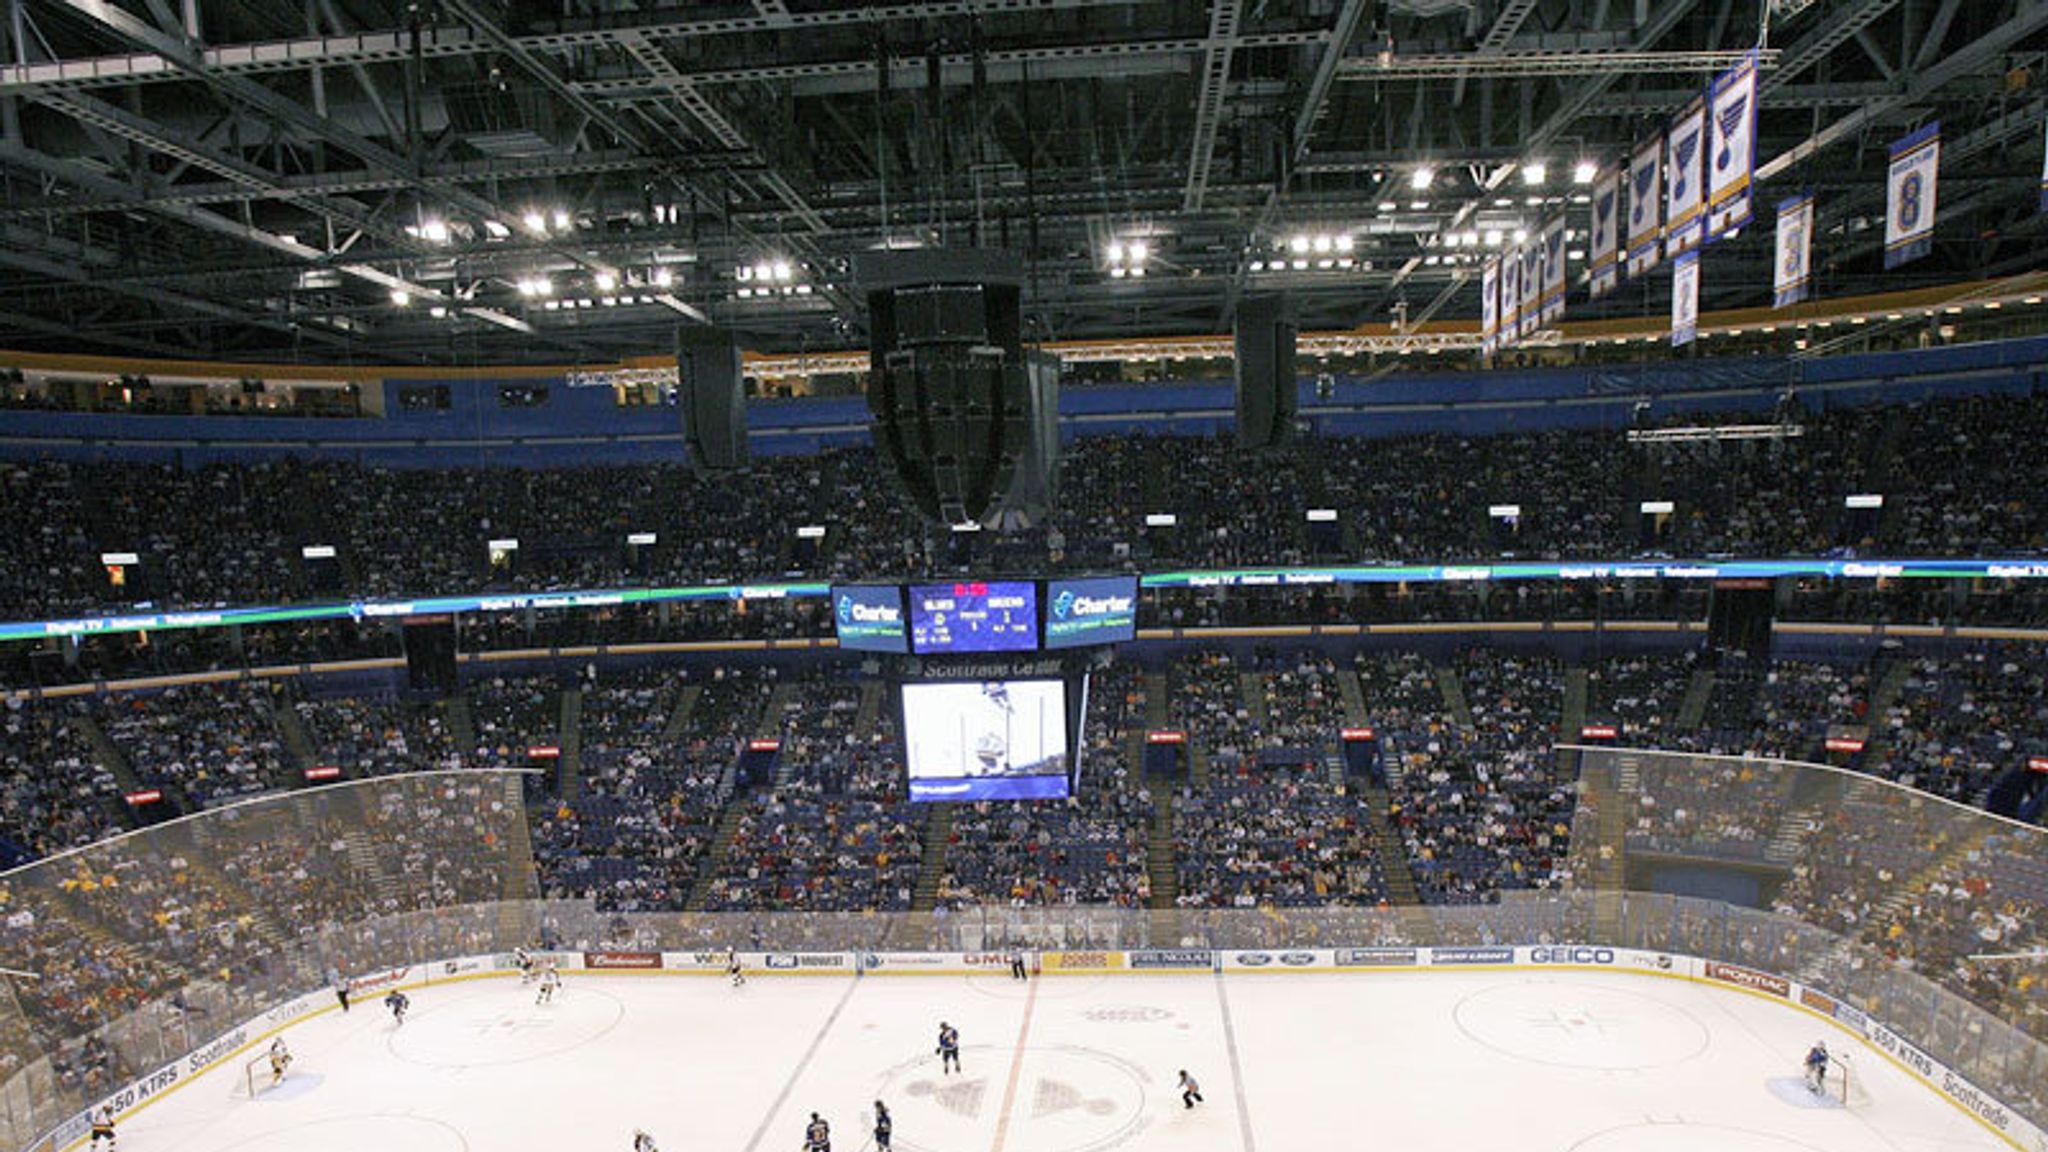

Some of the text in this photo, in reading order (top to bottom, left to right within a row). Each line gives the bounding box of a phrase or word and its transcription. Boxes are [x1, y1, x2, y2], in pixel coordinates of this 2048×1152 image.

[1898, 170, 1922, 233] 8
[852, 603, 899, 621] Charter
[1072, 595, 1131, 616] Charter
[1531, 947, 1614, 964] GEICO
[1873, 1027, 1932, 1077] 550 KTRS
[138, 1065, 179, 1100] KTRS
[1943, 1072, 2010, 1131] Scottrade
